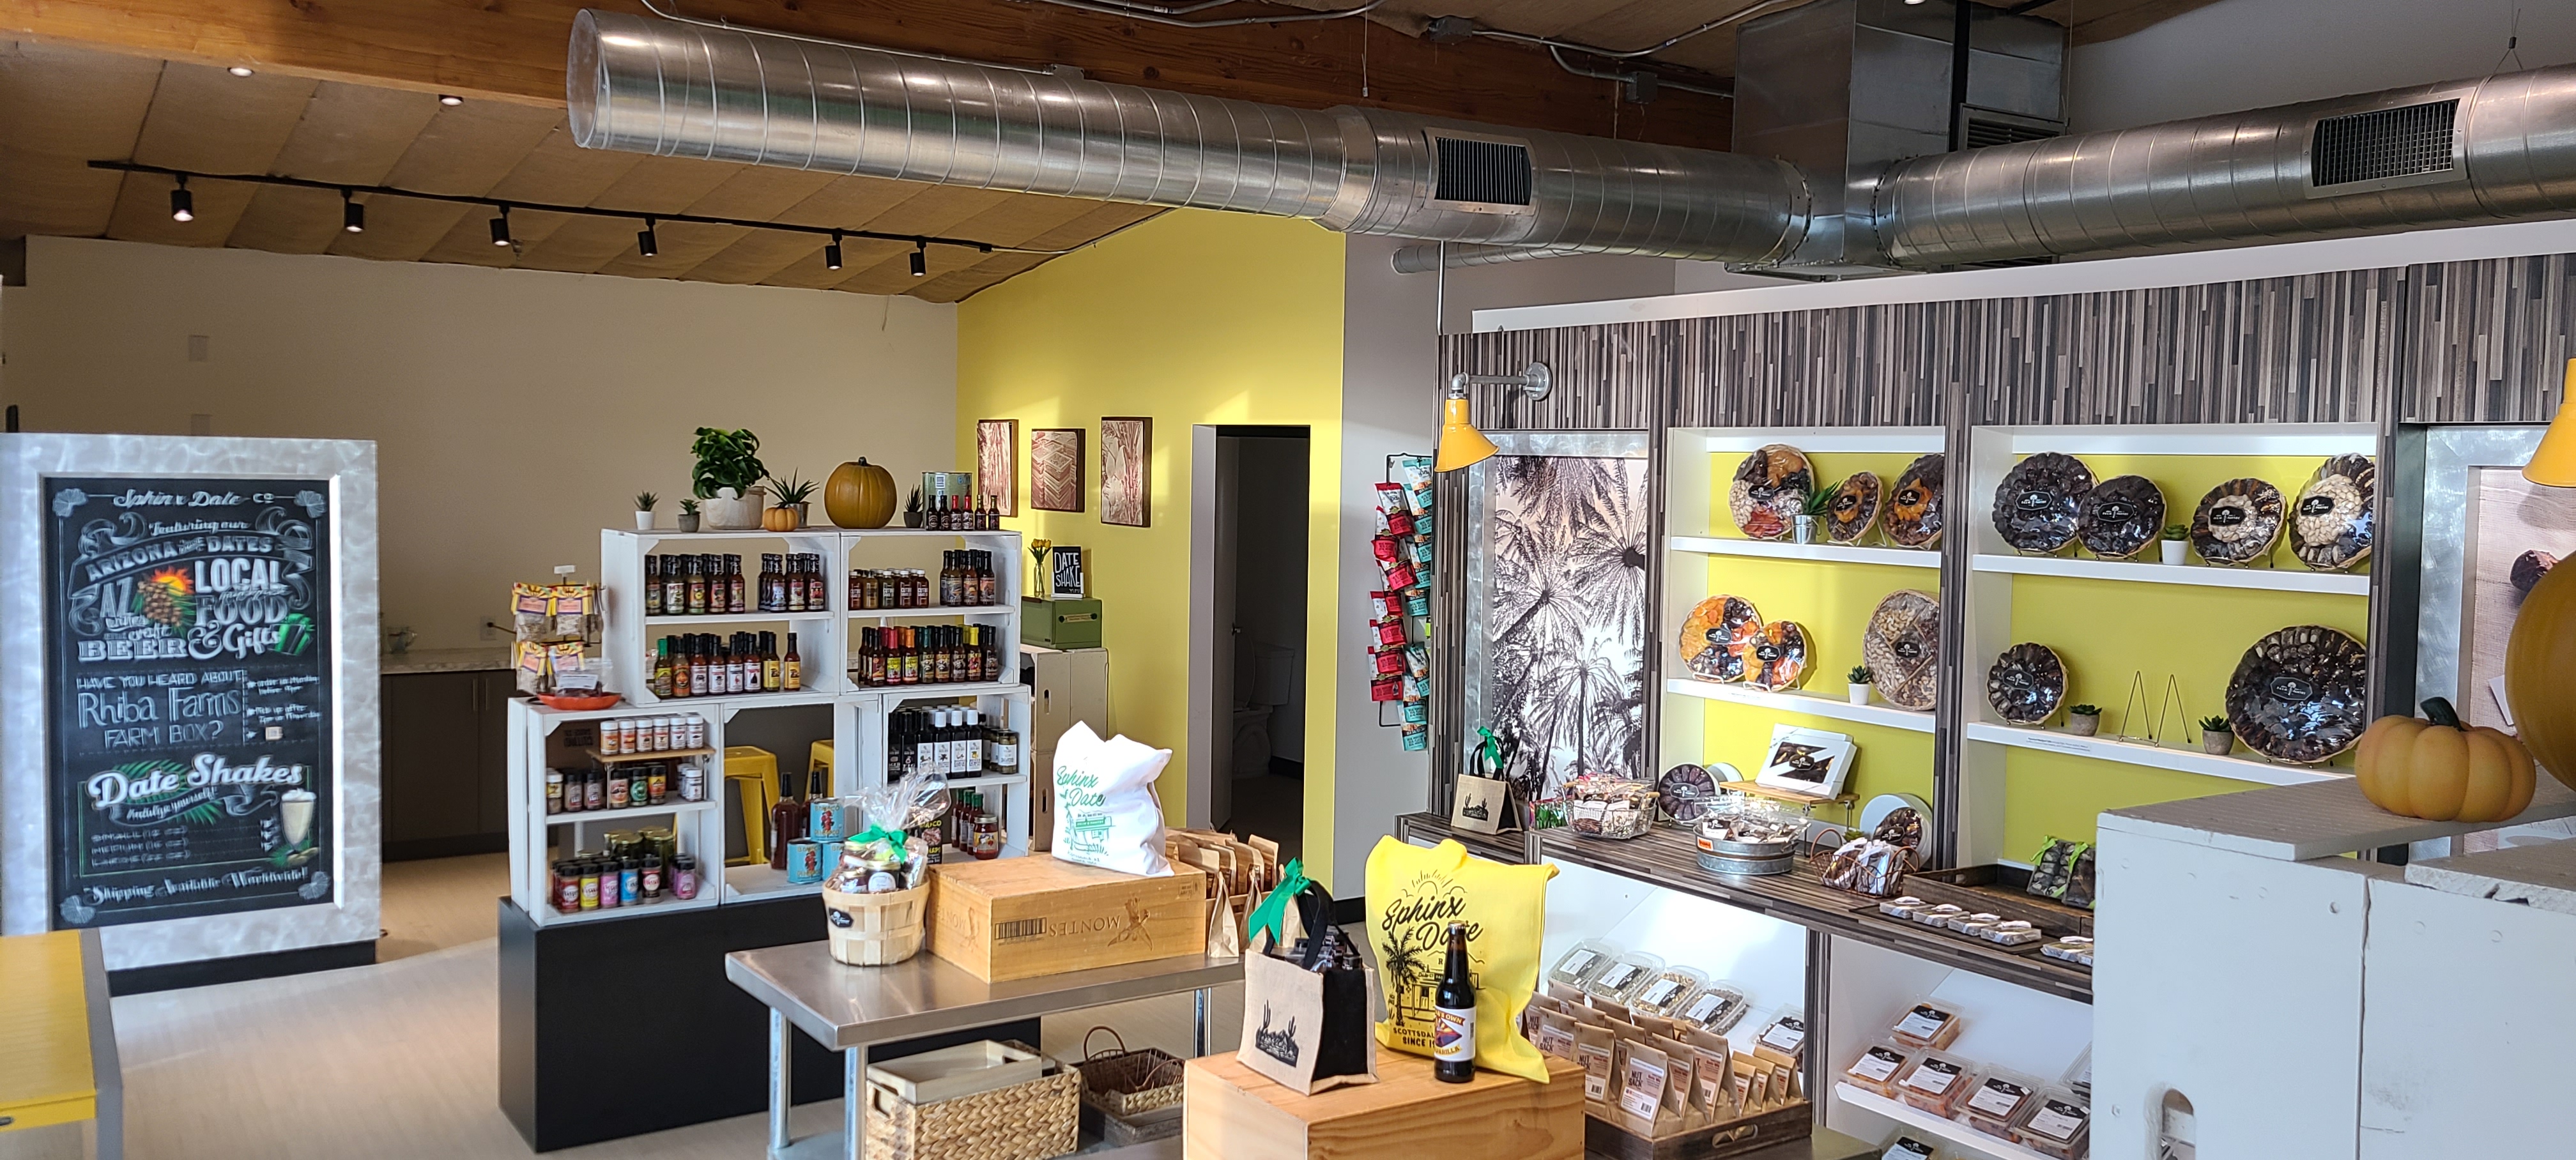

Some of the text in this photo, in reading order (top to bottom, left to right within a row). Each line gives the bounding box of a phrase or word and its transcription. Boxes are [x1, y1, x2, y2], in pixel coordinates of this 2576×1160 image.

[115, 489, 187, 507] Sphinx
[188, 491, 249, 507] Date
[85, 542, 177, 580] ARIZONA
[206, 536, 273, 553] DATES
[1054, 552, 1079, 574] DATE
[194, 558, 282, 593] LOCAL
[1055, 565, 1081, 588] SHAKE
[99, 576, 135, 618] AZ
[195, 595, 288, 627] FOOD
[77, 639, 189, 662] BEER
[188, 620, 282, 660] & Gifts
[77, 675, 116, 690] HAVE
[118, 674, 145, 688] YOU
[148, 671, 197, 686] HEARD
[77, 686, 242, 729] Rhiba Farms
[104, 720, 224, 749] FARM BOX?
[87, 752, 303, 808] Date Shakes
[1056, 765, 1100, 789] Sphinx
[1069, 788, 1107, 807] Date
[83, 883, 155, 906] Shipping
[1049, 915, 1120, 937] MONTES
[1382, 896, 1467, 935] Sphinx
[1445, 1013, 1462, 1025] OWN
[1530, 1015, 1540, 1023] NUT
[1393, 1026, 1435, 1039] SCOTTSDAL
[1402, 1037, 1427, 1048] SINCE
[1542, 1035, 1554, 1044] NUT
[1539, 1042, 1554, 1053] SACK
[1579, 1054, 1590, 1064] NUT
[1628, 1078, 1643, 1088] SACK
[1631, 1069, 1643, 1080] NUT
